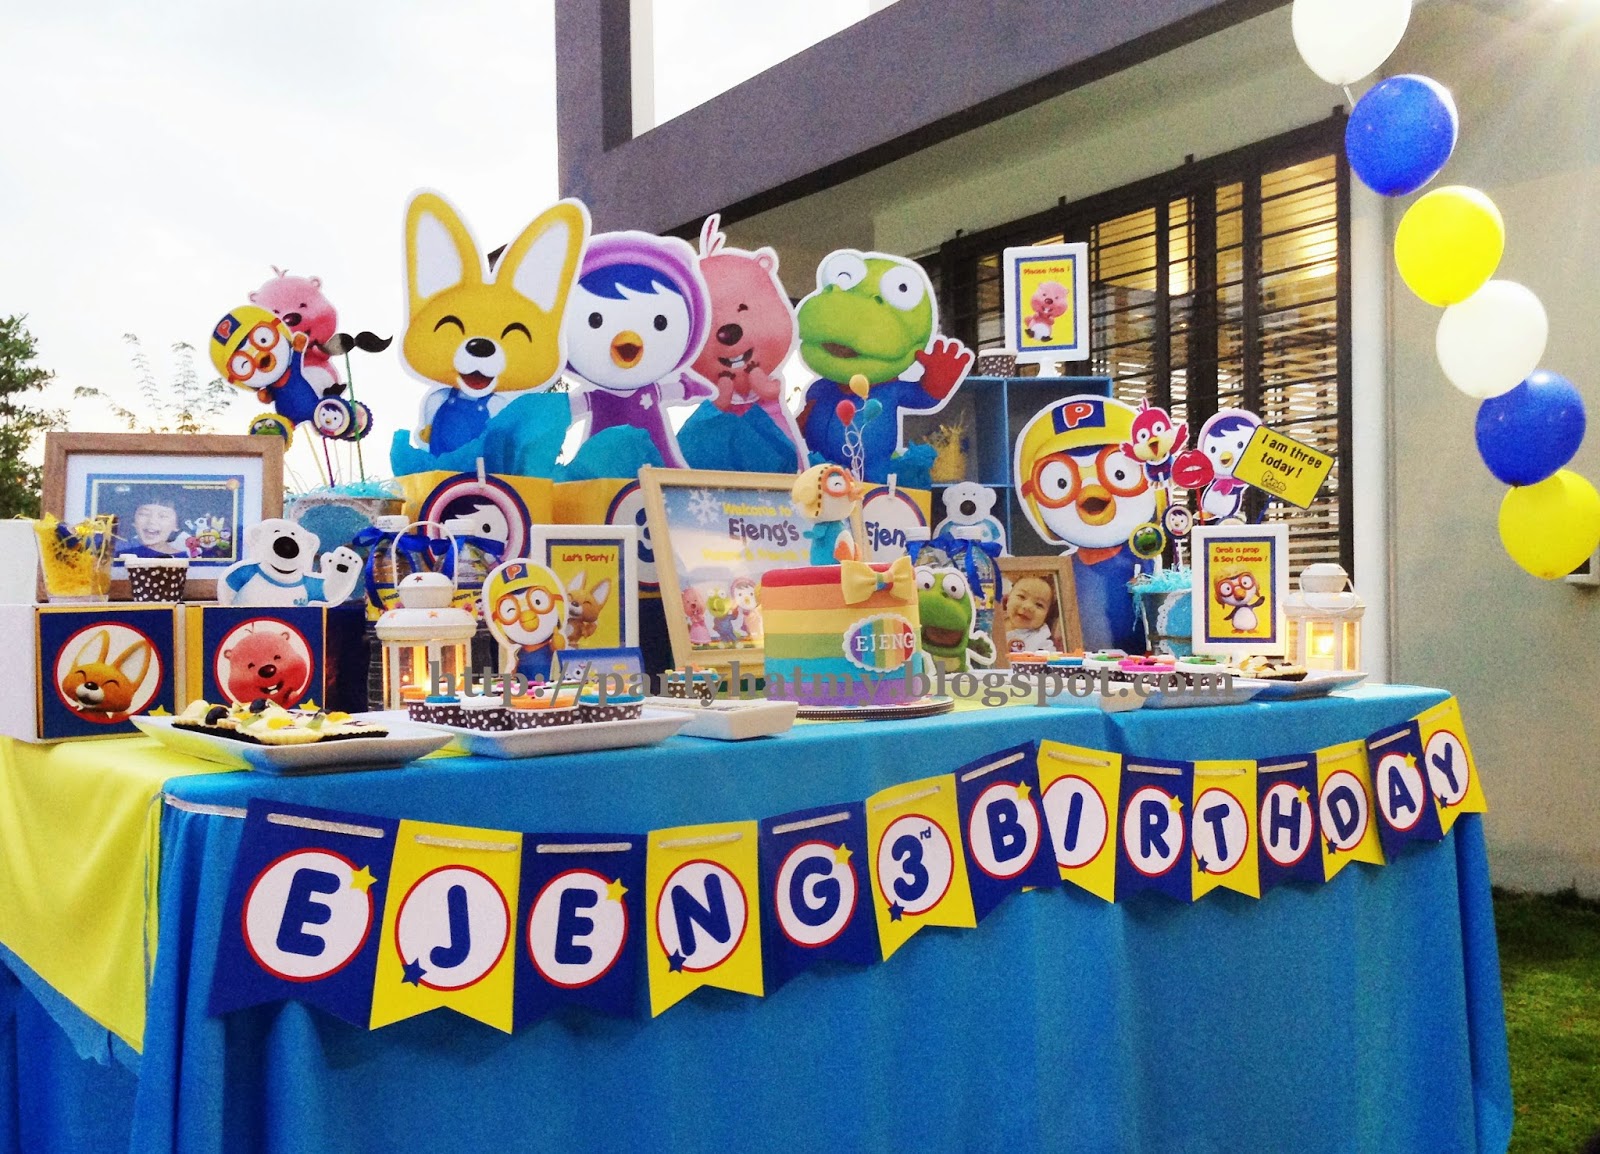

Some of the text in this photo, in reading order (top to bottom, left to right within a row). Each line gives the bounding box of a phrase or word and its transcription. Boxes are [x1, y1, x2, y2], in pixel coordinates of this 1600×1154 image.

[217, 319, 232, 339] P
[1062, 402, 1094, 429] P
[1261, 433, 1322, 469] I am three
[1260, 452, 1295, 476] today
[864, 521, 906, 552] Ejen
[562, 553, 583, 562] Let's
[585, 553, 609, 564] Party
[1215, 546, 1234, 554] Grab
[1242, 546, 1260, 555] prop
[1221, 555, 1234, 564] Say
[1236, 555, 1263, 563] Cheese
[506, 564, 523, 581] P
[855, 632, 914, 652] EJENG
